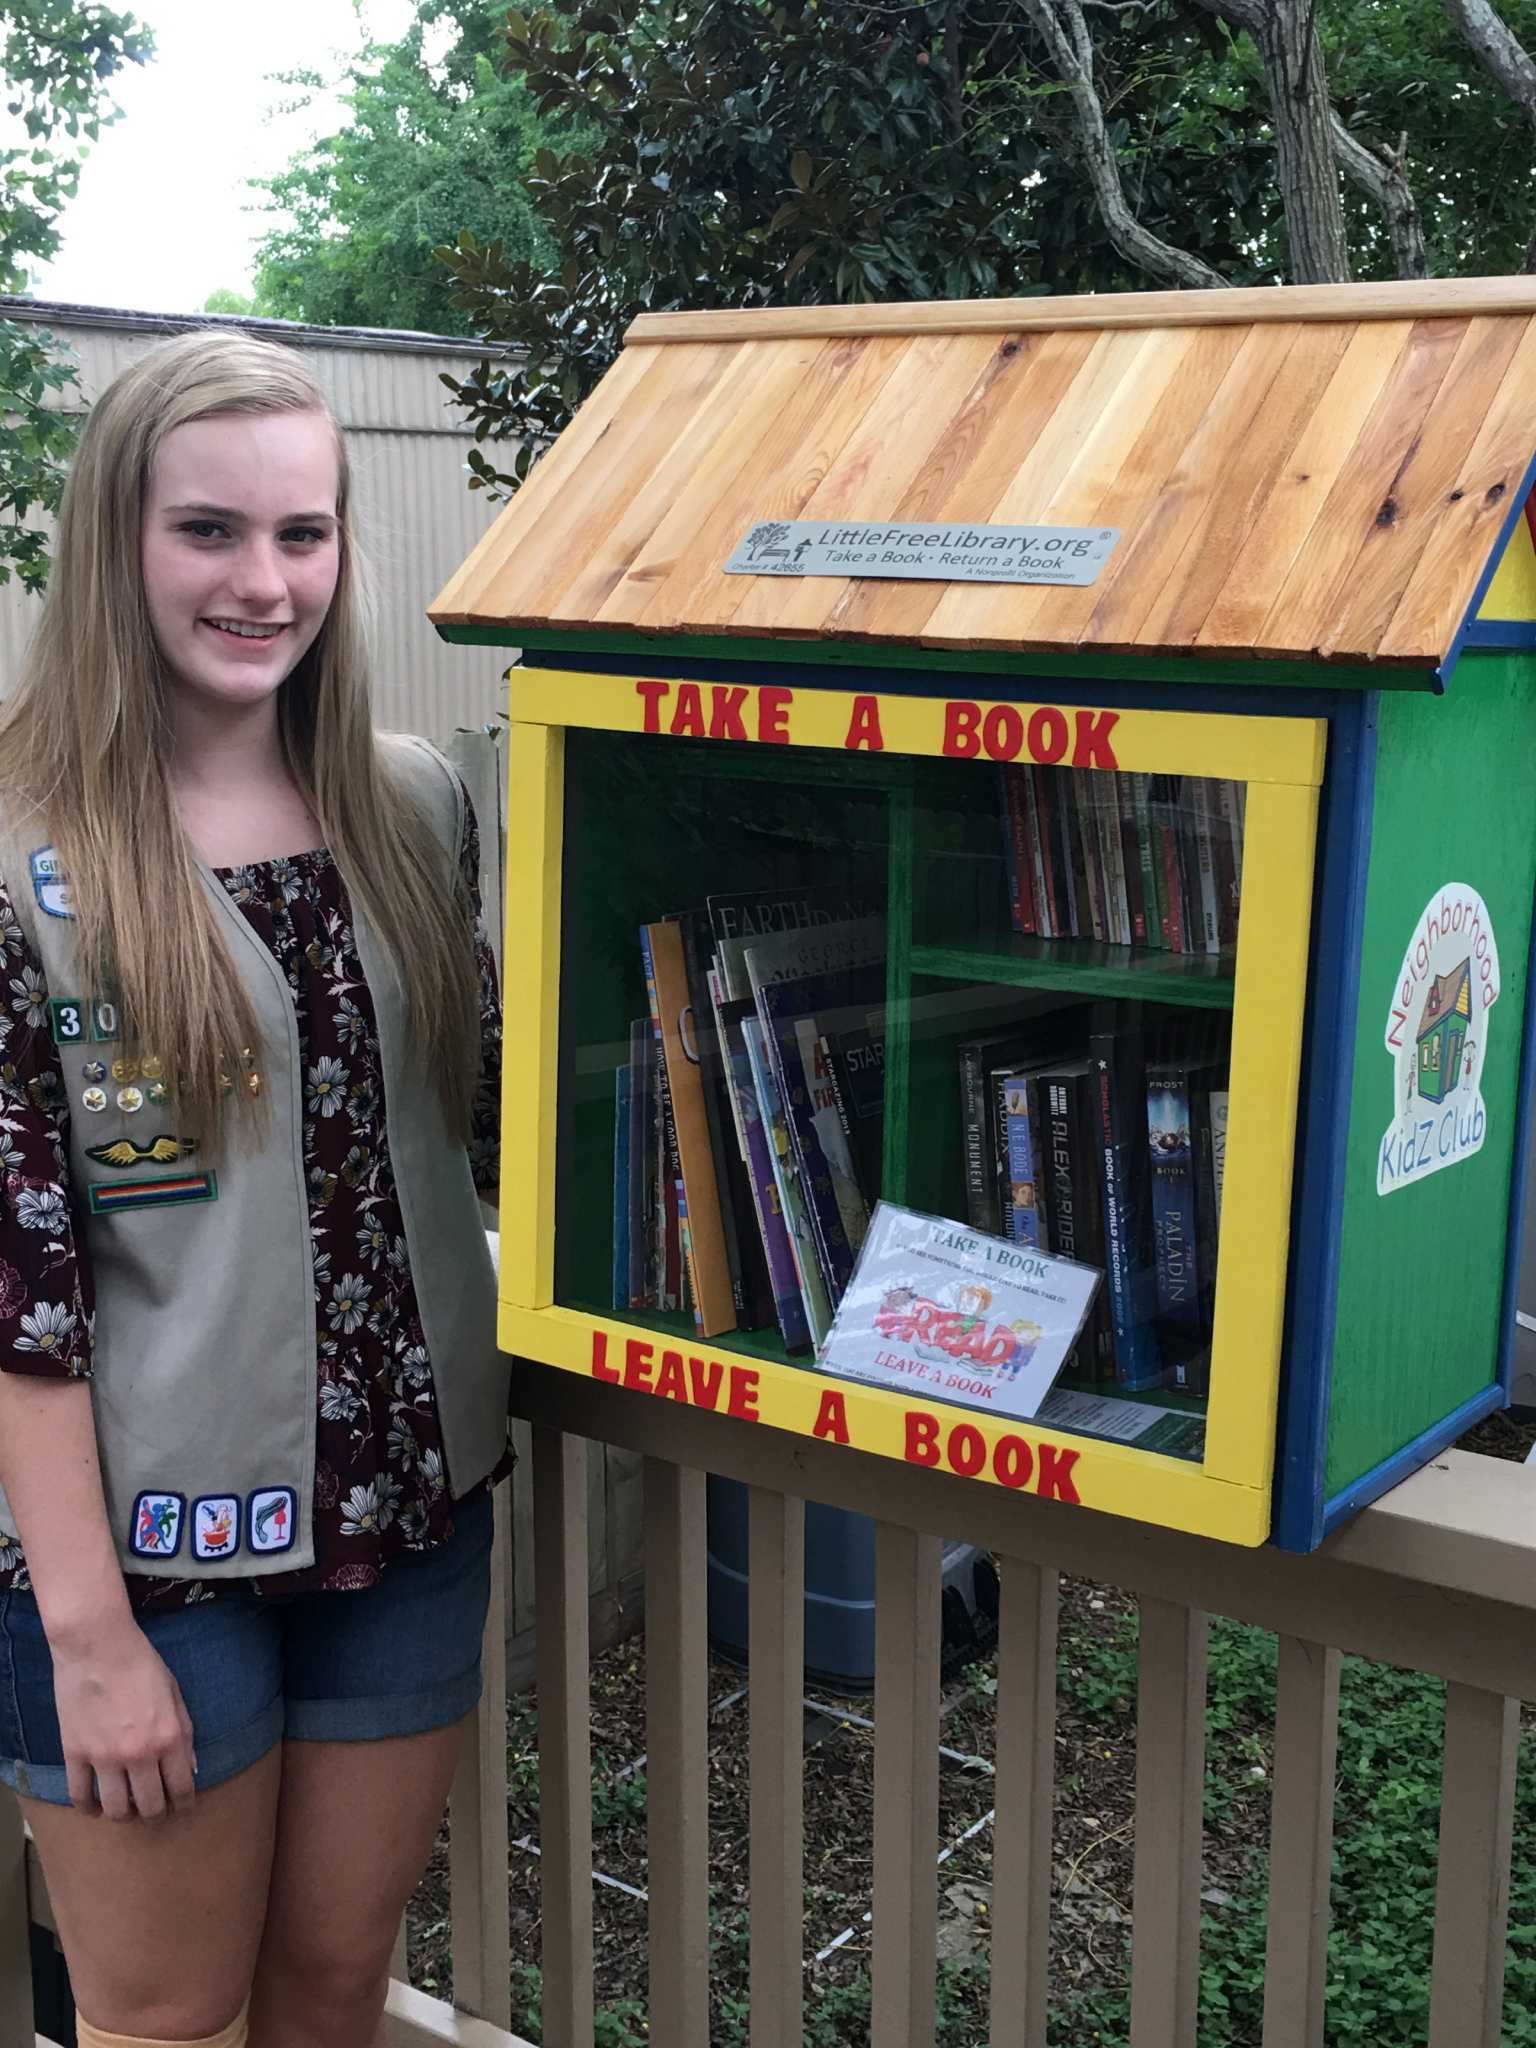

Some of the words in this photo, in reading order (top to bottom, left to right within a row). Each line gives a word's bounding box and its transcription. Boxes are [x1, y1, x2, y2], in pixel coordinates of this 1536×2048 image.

[818, 528, 1093, 557] LittleFreeLibrary.org
[825, 550, 862, 563] Take
[865, 554, 875, 563] a
[881, 550, 923, 564] Book
[939, 552, 997, 566] Return
[1002, 558, 1012, 567] a
[1018, 556, 1065, 569] Book
[975, 568, 1016, 577] Nonprofit
[1018, 570, 1076, 580] Organization
[636, 681, 793, 744] TAKE
[844, 695, 884, 751] A
[942, 701, 1119, 769] BOOK
[1386, 896, 1496, 1047] Neighborhood
[825, 1057, 844, 1114] STARGAZING
[1098, 1072, 1113, 1147] SCHOLASTIC
[1148, 1080, 1184, 1090] FROST
[967, 1124, 984, 1193] MONUMENT
[1012, 1147, 1029, 1179] BODE
[1051, 1120, 1071, 1178] ALEX
[1103, 1148, 1114, 1184] BOOK
[1380, 1119, 1434, 1185] KidZ
[1438, 1097, 1485, 1158] Club
[1156, 1167, 1187, 1176] BOOK
[1107, 1197, 1119, 1240] WORLD
[932, 1225, 979, 1257] TAKE
[996, 1248, 1050, 1279] BOOK
[1110, 1240, 1124, 1296] RECORDS
[1165, 1211, 1185, 1303] PALADIN
[907, 1296, 1017, 1366] READ
[874, 1350, 930, 1381] LEAVE
[929, 1367, 945, 1383] A
[944, 1374, 997, 1399] BOOK
[592, 1330, 760, 1422] LEAVE
[812, 1389, 850, 1444] A
[904, 1411, 1081, 1505] BOOK
